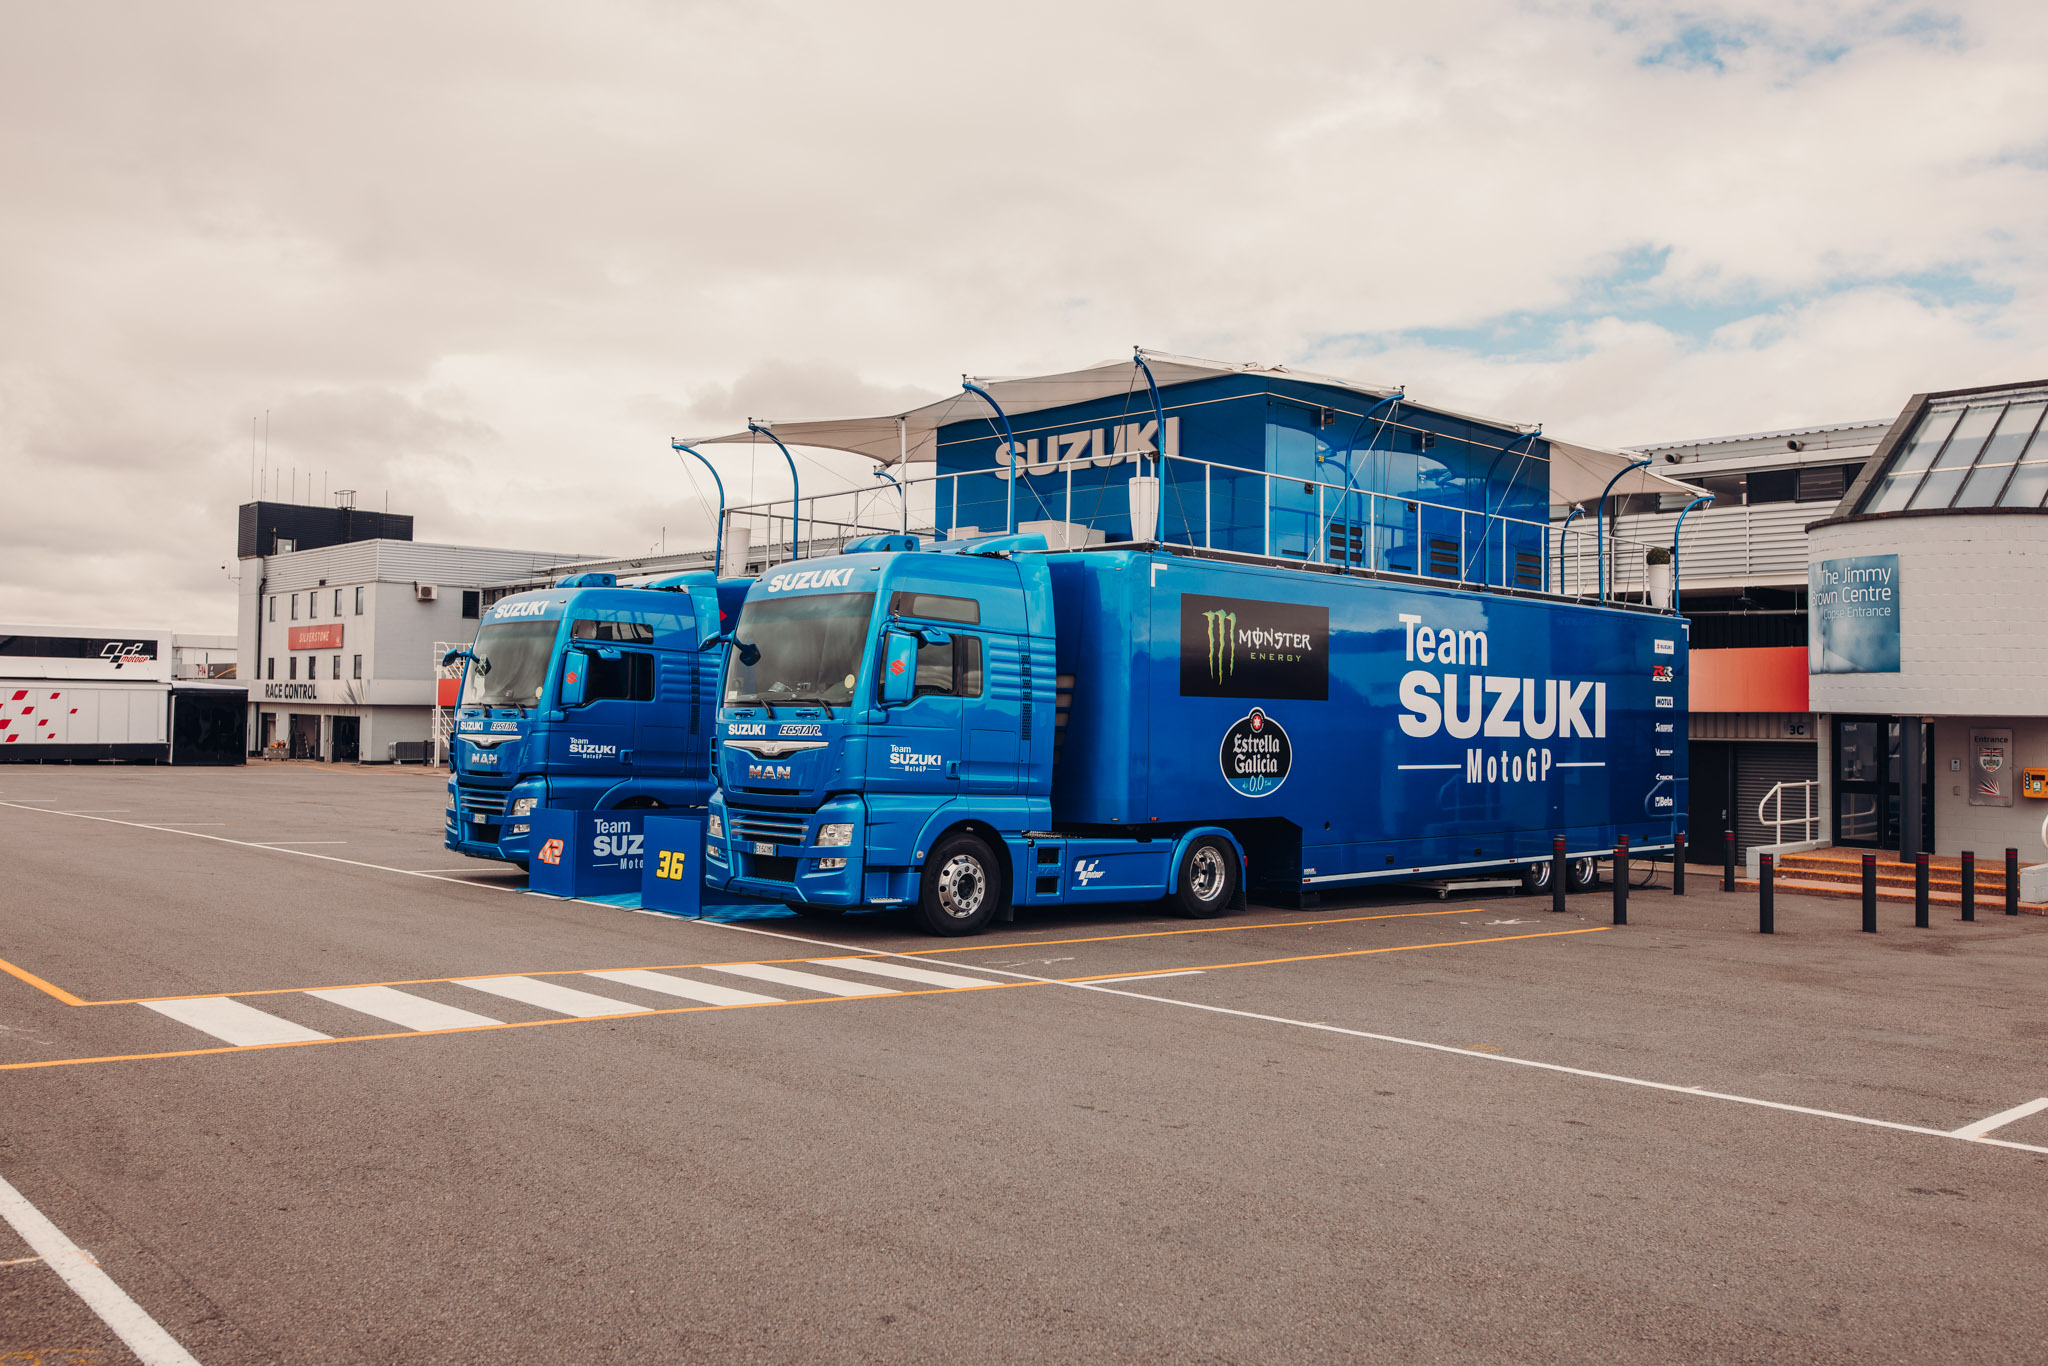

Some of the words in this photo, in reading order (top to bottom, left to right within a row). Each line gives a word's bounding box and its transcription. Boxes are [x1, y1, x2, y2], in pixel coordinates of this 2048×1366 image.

[995, 416, 1180, 481] SUZUKI
[767, 567, 855, 593] SUZUKI
[1820, 568, 1838, 585] The
[1842, 566, 1892, 585] Jimmy
[1812, 590, 1838, 607] Brown
[1842, 586, 1891, 603] Centre
[494, 600, 550, 619] SUZUKI
[1823, 608, 1845, 621] Copse
[1847, 607, 1891, 618] Entrance
[299, 631, 330, 643] SILVERSTONE
[1239, 627, 1312, 651] MONSTER
[1399, 613, 1488, 667] Team
[1250, 652, 1301, 662] ENERGY
[265, 683, 283, 698] RACE
[284, 683, 317, 700] CONTROL
[1398, 669, 1606, 740] SUZUKI
[1656, 698, 1673, 706] MOTUL
[460, 721, 483, 731] SUZUKI
[728, 723, 766, 736] SUZUKI
[778, 724, 822, 736] ECSTAR
[1789, 724, 1804, 735] 3C
[570, 736, 589, 745] Team
[1232, 733, 1280, 753] Estrella
[1974, 736, 2009, 744] Entrance
[569, 743, 616, 754] SUZUKI
[890, 744, 912, 753] Team
[471, 753, 498, 765] MAN
[889, 753, 942, 766] SUZUKI
[1234, 753, 1278, 774] Galicia
[1466, 747, 1552, 784] MotoGP
[748, 764, 791, 780] MAN
[594, 818, 631, 834] Team
[656, 850, 685, 881] 36
